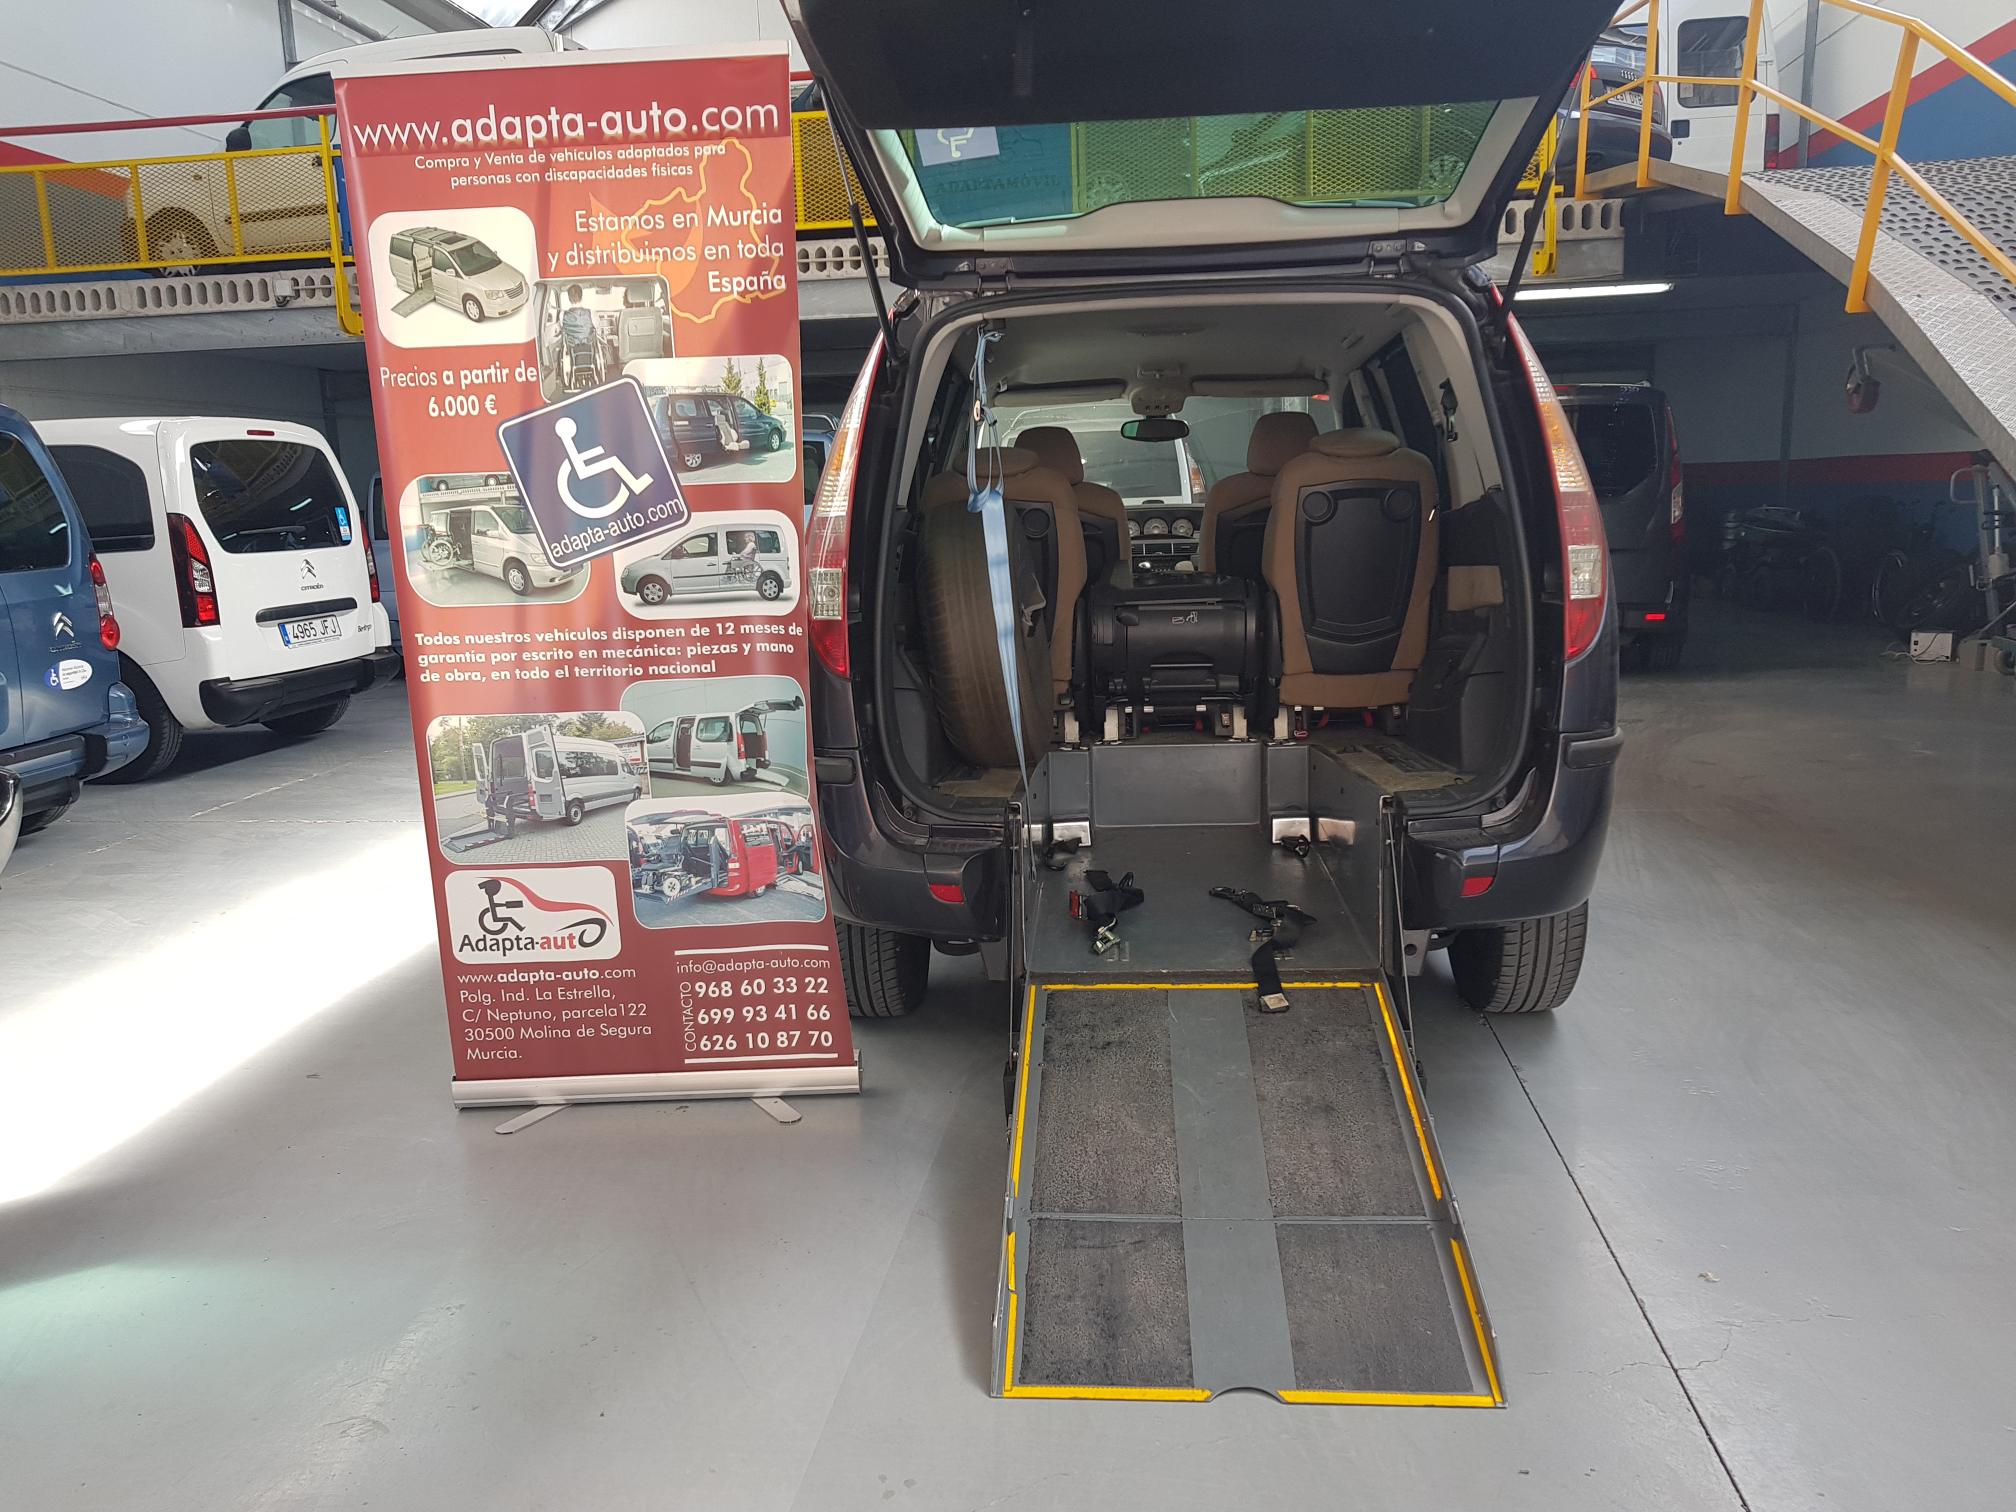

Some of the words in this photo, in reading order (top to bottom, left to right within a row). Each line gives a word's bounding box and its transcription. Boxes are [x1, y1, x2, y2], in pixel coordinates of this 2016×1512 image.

[353, 101, 779, 147] www.adapta-auto.com
[415, 153, 470, 173] Compra
[474, 155, 481, 171] y
[485, 151, 524, 166] Venta
[528, 149, 545, 164] de
[550, 147, 612, 162] vehículos
[617, 144, 689, 160] adaptados
[694, 143, 725, 157] para
[450, 172, 512, 189] personas
[516, 171, 540, 183] con
[545, 164, 647, 184] discapacidades
[651, 163, 693, 177] físicas
[576, 211, 665, 232] Estamos
[672, 212, 699, 228] en
[708, 202, 782, 226] Murcia
[548, 250, 559, 271] y
[566, 242, 696, 265] distribuimos
[705, 243, 730, 260] en
[737, 235, 784, 258] toda
[708, 270, 786, 296] España
[380, 367, 437, 387] Precios
[443, 371, 453, 385] a
[460, 364, 509, 389] partir
[515, 362, 537, 382] de
[428, 397, 479, 417] 6.000
[484, 395, 498, 415] €
[550, 498, 684, 559] adapta-auto.com
[292, 622, 318, 639] 4965
[320, 618, 337, 635] JFJ
[415, 633, 460, 646] Todos
[465, 631, 530, 644] nuestros
[535, 627, 608, 643] vehículos
[613, 625, 685, 641] disponen
[691, 623, 710, 637] de
[716, 623, 734, 636] 12
[740, 622, 785, 635] meses
[789, 623, 802, 636] de
[418, 651, 486, 667] garantía
[490, 651, 517, 664] por
[522, 648, 573, 661] escrito
[578, 647, 598, 659] en
[602, 644, 681, 658] mecánica:
[687, 642, 738, 659] piezas
[743, 643, 751, 655] y
[756, 642, 794, 653] mano
[420, 668, 440, 682] de
[445, 667, 486, 683] obra,
[491, 667, 510, 679] en
[515, 665, 549, 679] todo
[554, 664, 569, 677] el
[575, 662, 644, 677] territorio
[649, 661, 716, 674] nacional
[676, 956, 830, 973] info@adapta-auto.com
[457, 968, 635, 984] www.adapta-auto.com
[460, 990, 496, 1005] Polg.
[500, 987, 529, 1002] Ind.
[536, 987, 552, 1000] La
[557, 985, 616, 1000] Estrella,
[695, 980, 733, 998] 968
[740, 979, 766, 996] 60
[773, 977, 797, 994] 33
[805, 977, 828, 994] 22
[463, 1008, 482, 1023] C/
[487, 1008, 556, 1023] Neptuno,
[562, 1003, 647, 1020] parcela122
[680, 981, 697, 1052] CONTACTO
[697, 1006, 734, 1024] 699
[742, 1005, 767, 1023] 93
[775, 1004, 797, 1021] 41
[807, 1003, 830, 1021] 66
[465, 1027, 514, 1041] 30500
[520, 1024, 571, 1039] Molina
[576, 1023, 596, 1037] de
[600, 1022, 652, 1039] Segura
[700, 1034, 737, 1051] 626
[746, 1032, 769, 1049] 10
[776, 1031, 800, 1048] 87
[809, 1030, 832, 1047] 70
[466, 1046, 522, 1060] Murcia.
